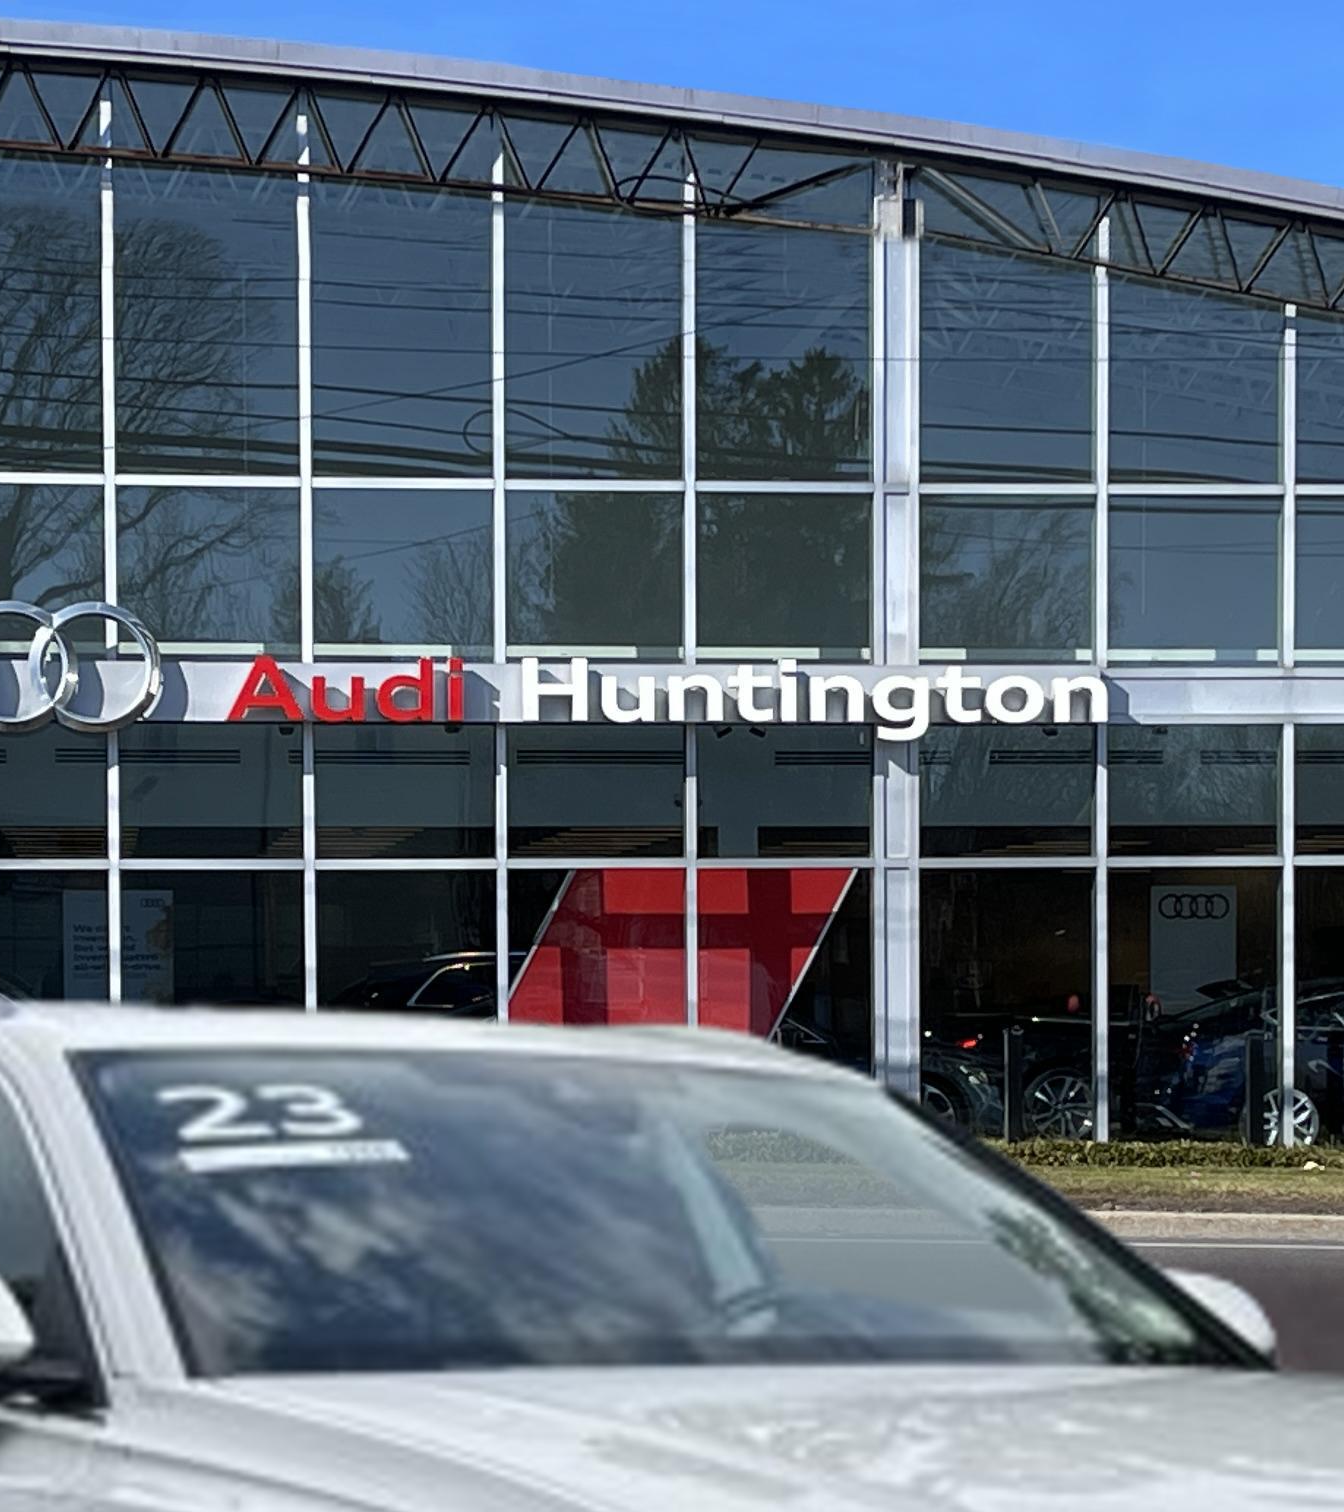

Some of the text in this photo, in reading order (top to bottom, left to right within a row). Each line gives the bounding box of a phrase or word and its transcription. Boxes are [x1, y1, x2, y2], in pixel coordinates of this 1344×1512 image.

[225, 655, 1109, 742] Audi Huntington
[157, 1085, 363, 1142] 23
